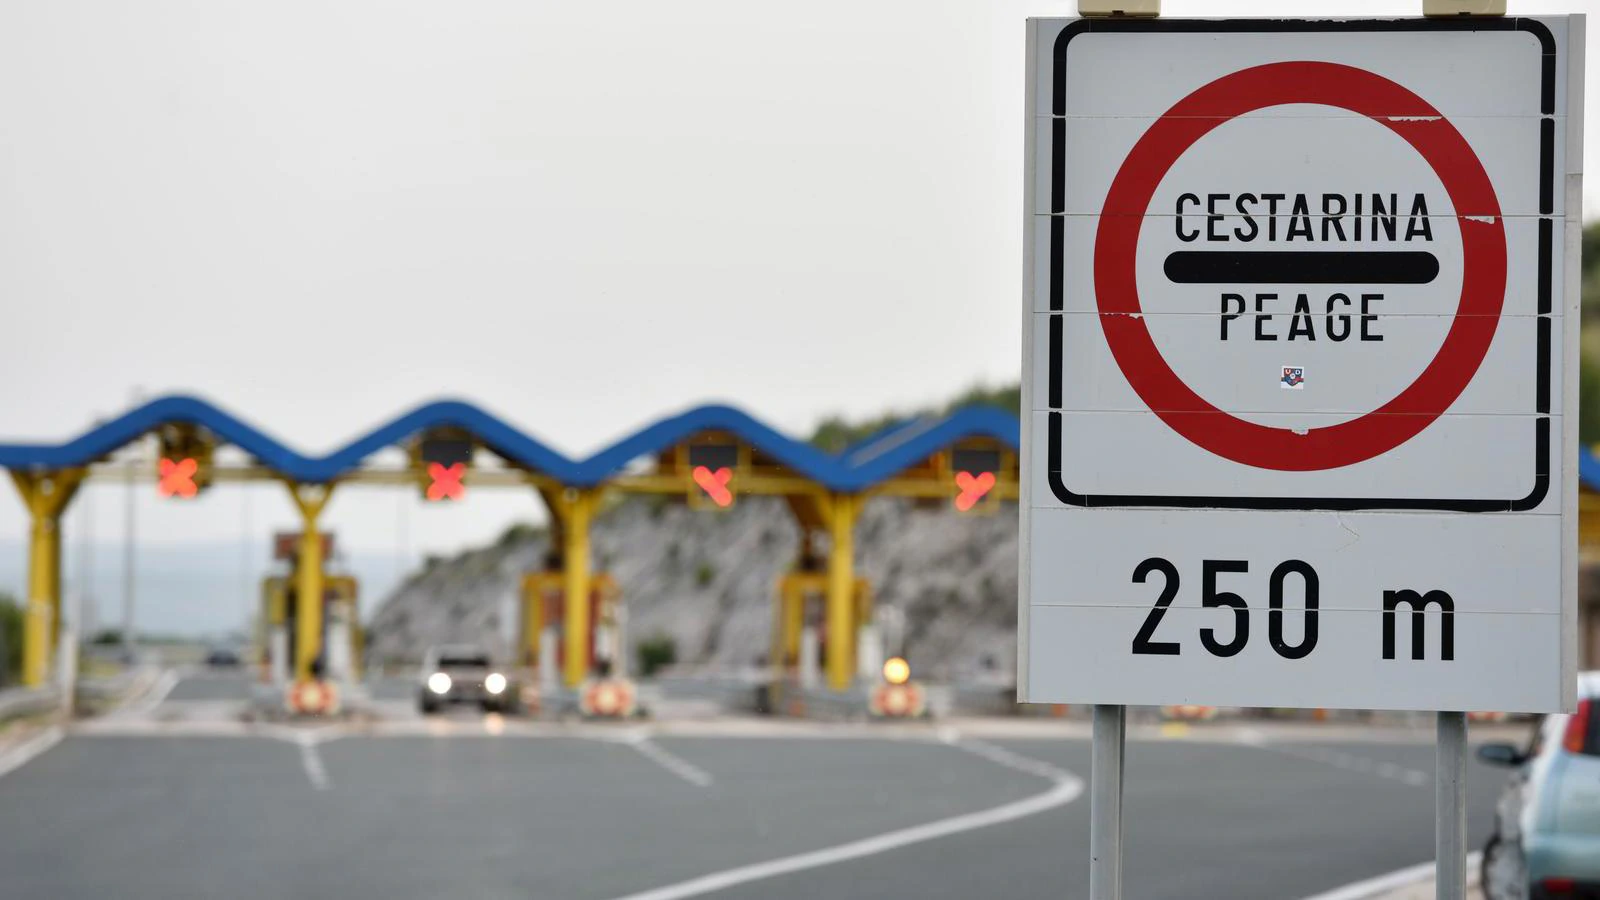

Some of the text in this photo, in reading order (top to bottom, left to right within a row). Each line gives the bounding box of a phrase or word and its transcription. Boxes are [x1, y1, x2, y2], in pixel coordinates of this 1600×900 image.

[1175, 192, 1434, 243] CESTARINA
[1220, 292, 1385, 342] PEAGE
[1131, 557, 1455, 661] 250 m
